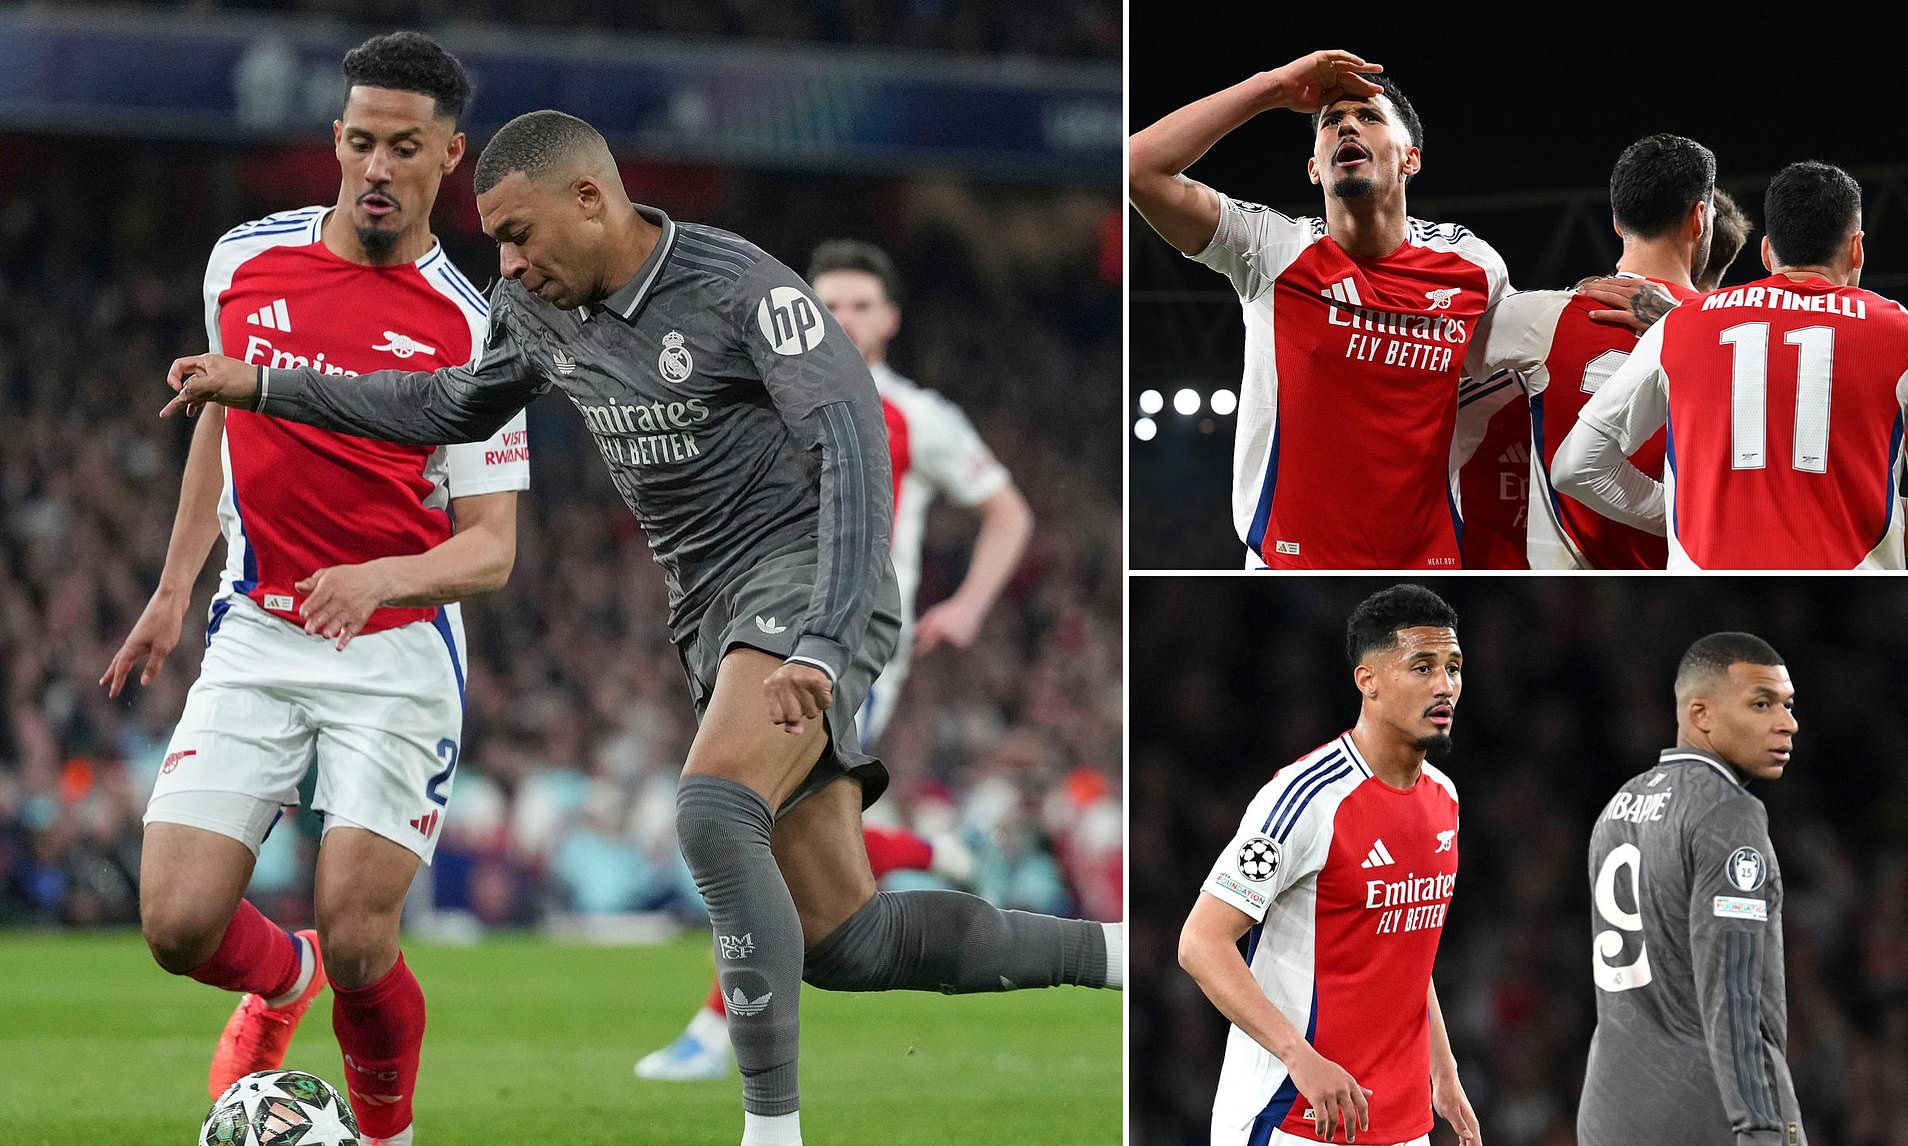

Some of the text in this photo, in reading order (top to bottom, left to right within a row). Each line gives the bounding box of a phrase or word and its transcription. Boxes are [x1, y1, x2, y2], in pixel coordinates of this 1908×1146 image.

[761, 288, 820, 354] hp
[1702, 286, 1866, 319] MARTINELLI
[1328, 300, 1466, 343] Emirates
[1346, 333, 1453, 372] FLY BETTER
[572, 397, 709, 433] mirates
[1720, 322, 1835, 473] 11
[502, 430, 527, 446] VISIT
[627, 430, 700, 465] BETTER
[426, 737, 458, 806] 2
[1741, 867, 1757, 877] 15
[1376, 904, 1446, 934] FLY BETTER
[1593, 843, 1652, 992] 9
